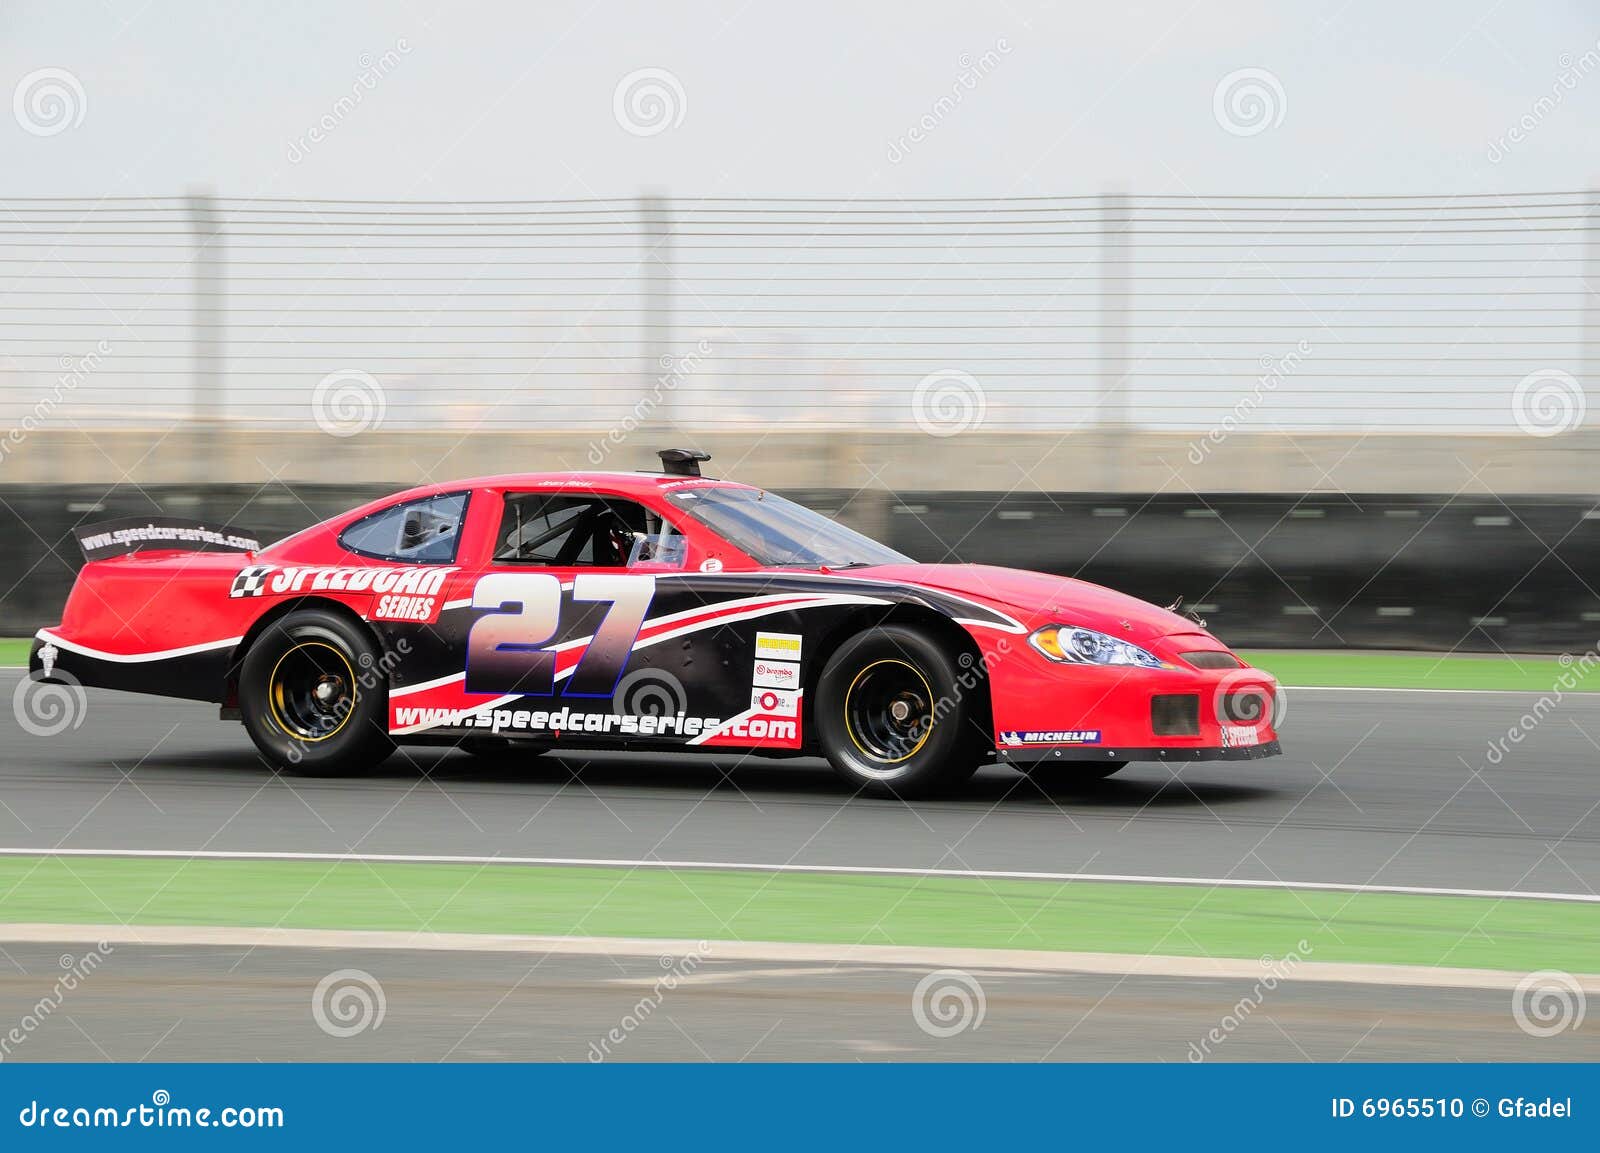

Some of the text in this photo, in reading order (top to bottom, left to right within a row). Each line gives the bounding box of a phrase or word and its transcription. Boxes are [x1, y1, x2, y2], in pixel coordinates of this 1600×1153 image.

[81, 523, 260, 551] www.speedcarseries.com
[375, 595, 434, 620] SERIES
[464, 573, 656, 698] 27
[766, 667, 792, 676] brembo
[394, 706, 797, 740] www.speedcarseries.com
[1024, 731, 1098, 741] MICHELIN
